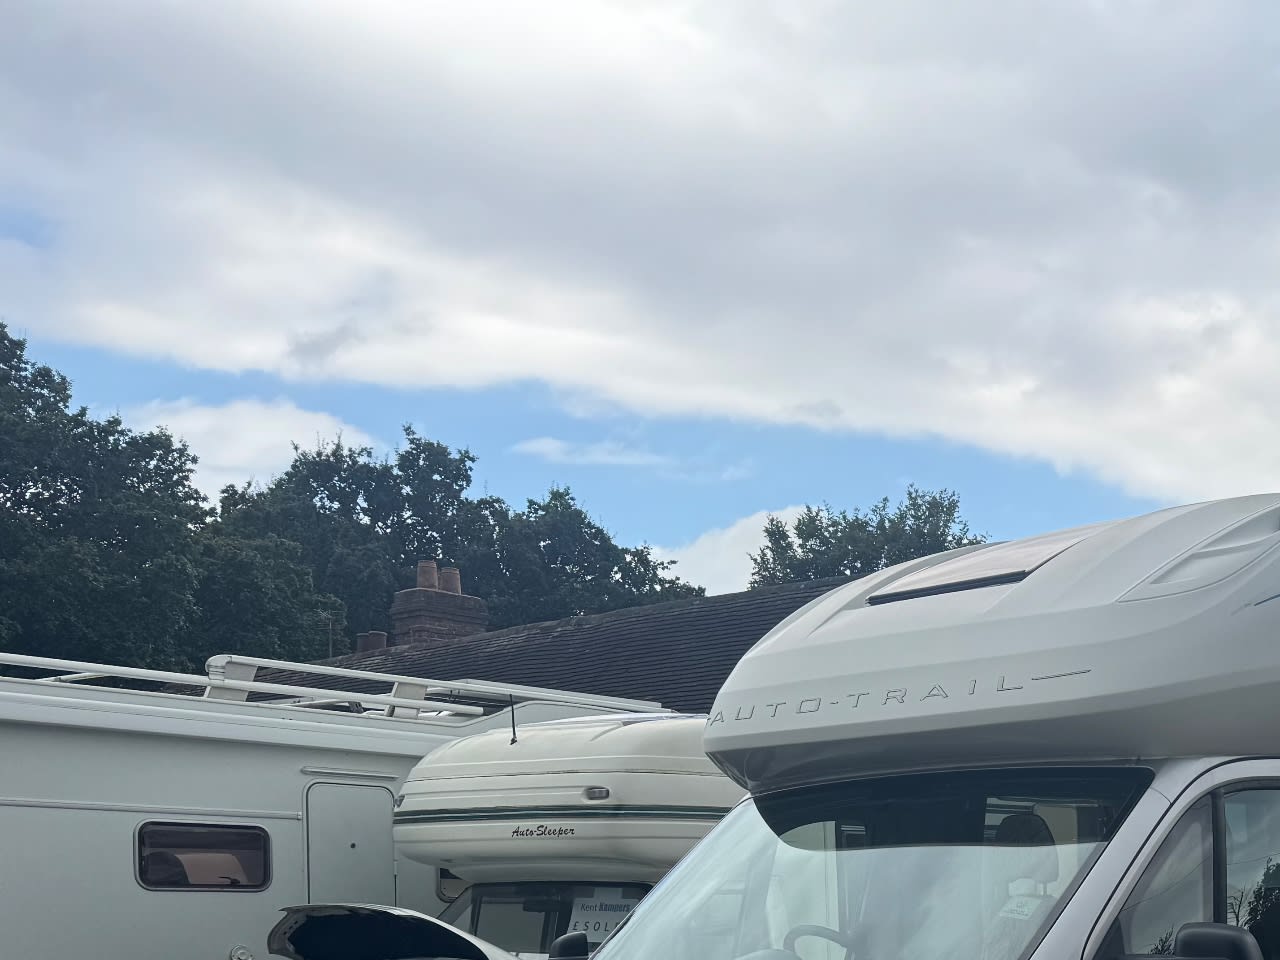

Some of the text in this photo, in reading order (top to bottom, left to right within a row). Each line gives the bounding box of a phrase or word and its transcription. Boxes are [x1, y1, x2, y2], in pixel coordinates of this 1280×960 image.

[709, 675, 1023, 726] AUTO-TRAIL
[512, 825, 575, 838] Auto-Sleeper
[580, 903, 598, 912] Kent
